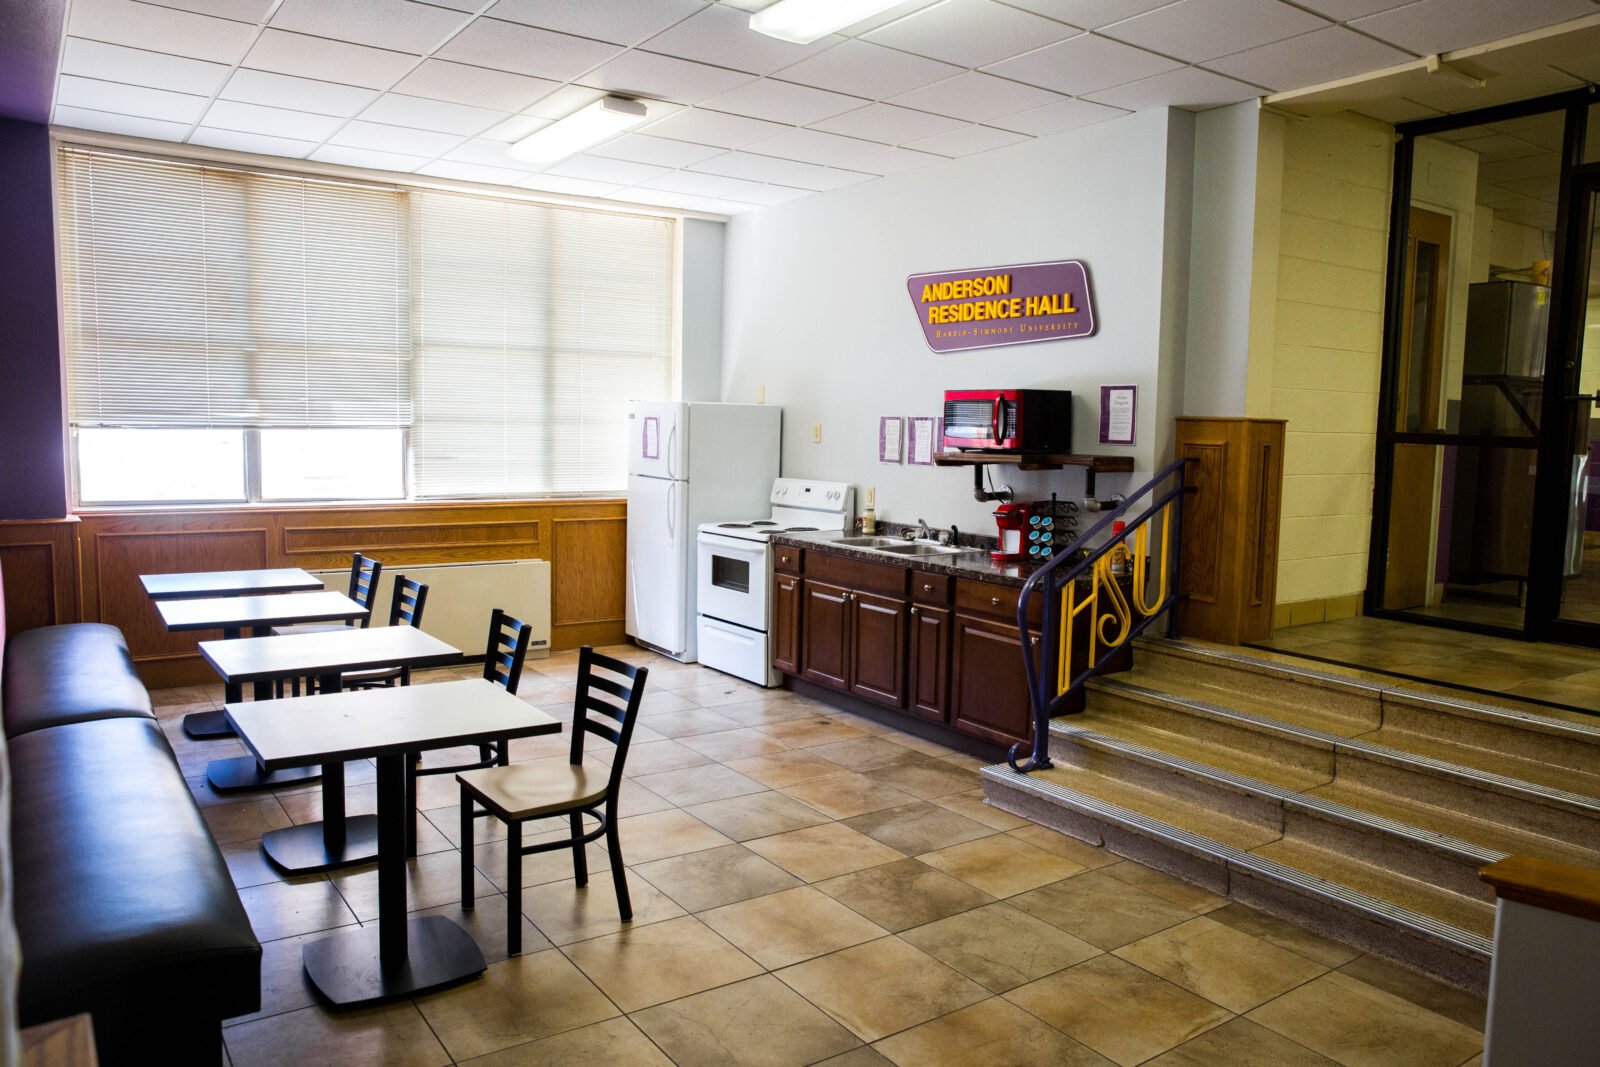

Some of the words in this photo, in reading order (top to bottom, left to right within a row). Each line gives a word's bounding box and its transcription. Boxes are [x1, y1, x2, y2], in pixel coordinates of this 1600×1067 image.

[921, 274, 1011, 303] ANDERSON
[928, 297, 1023, 325] RESIDENCE
[1025, 292, 1078, 317] HALL
[1057, 501, 1171, 697] HSU
